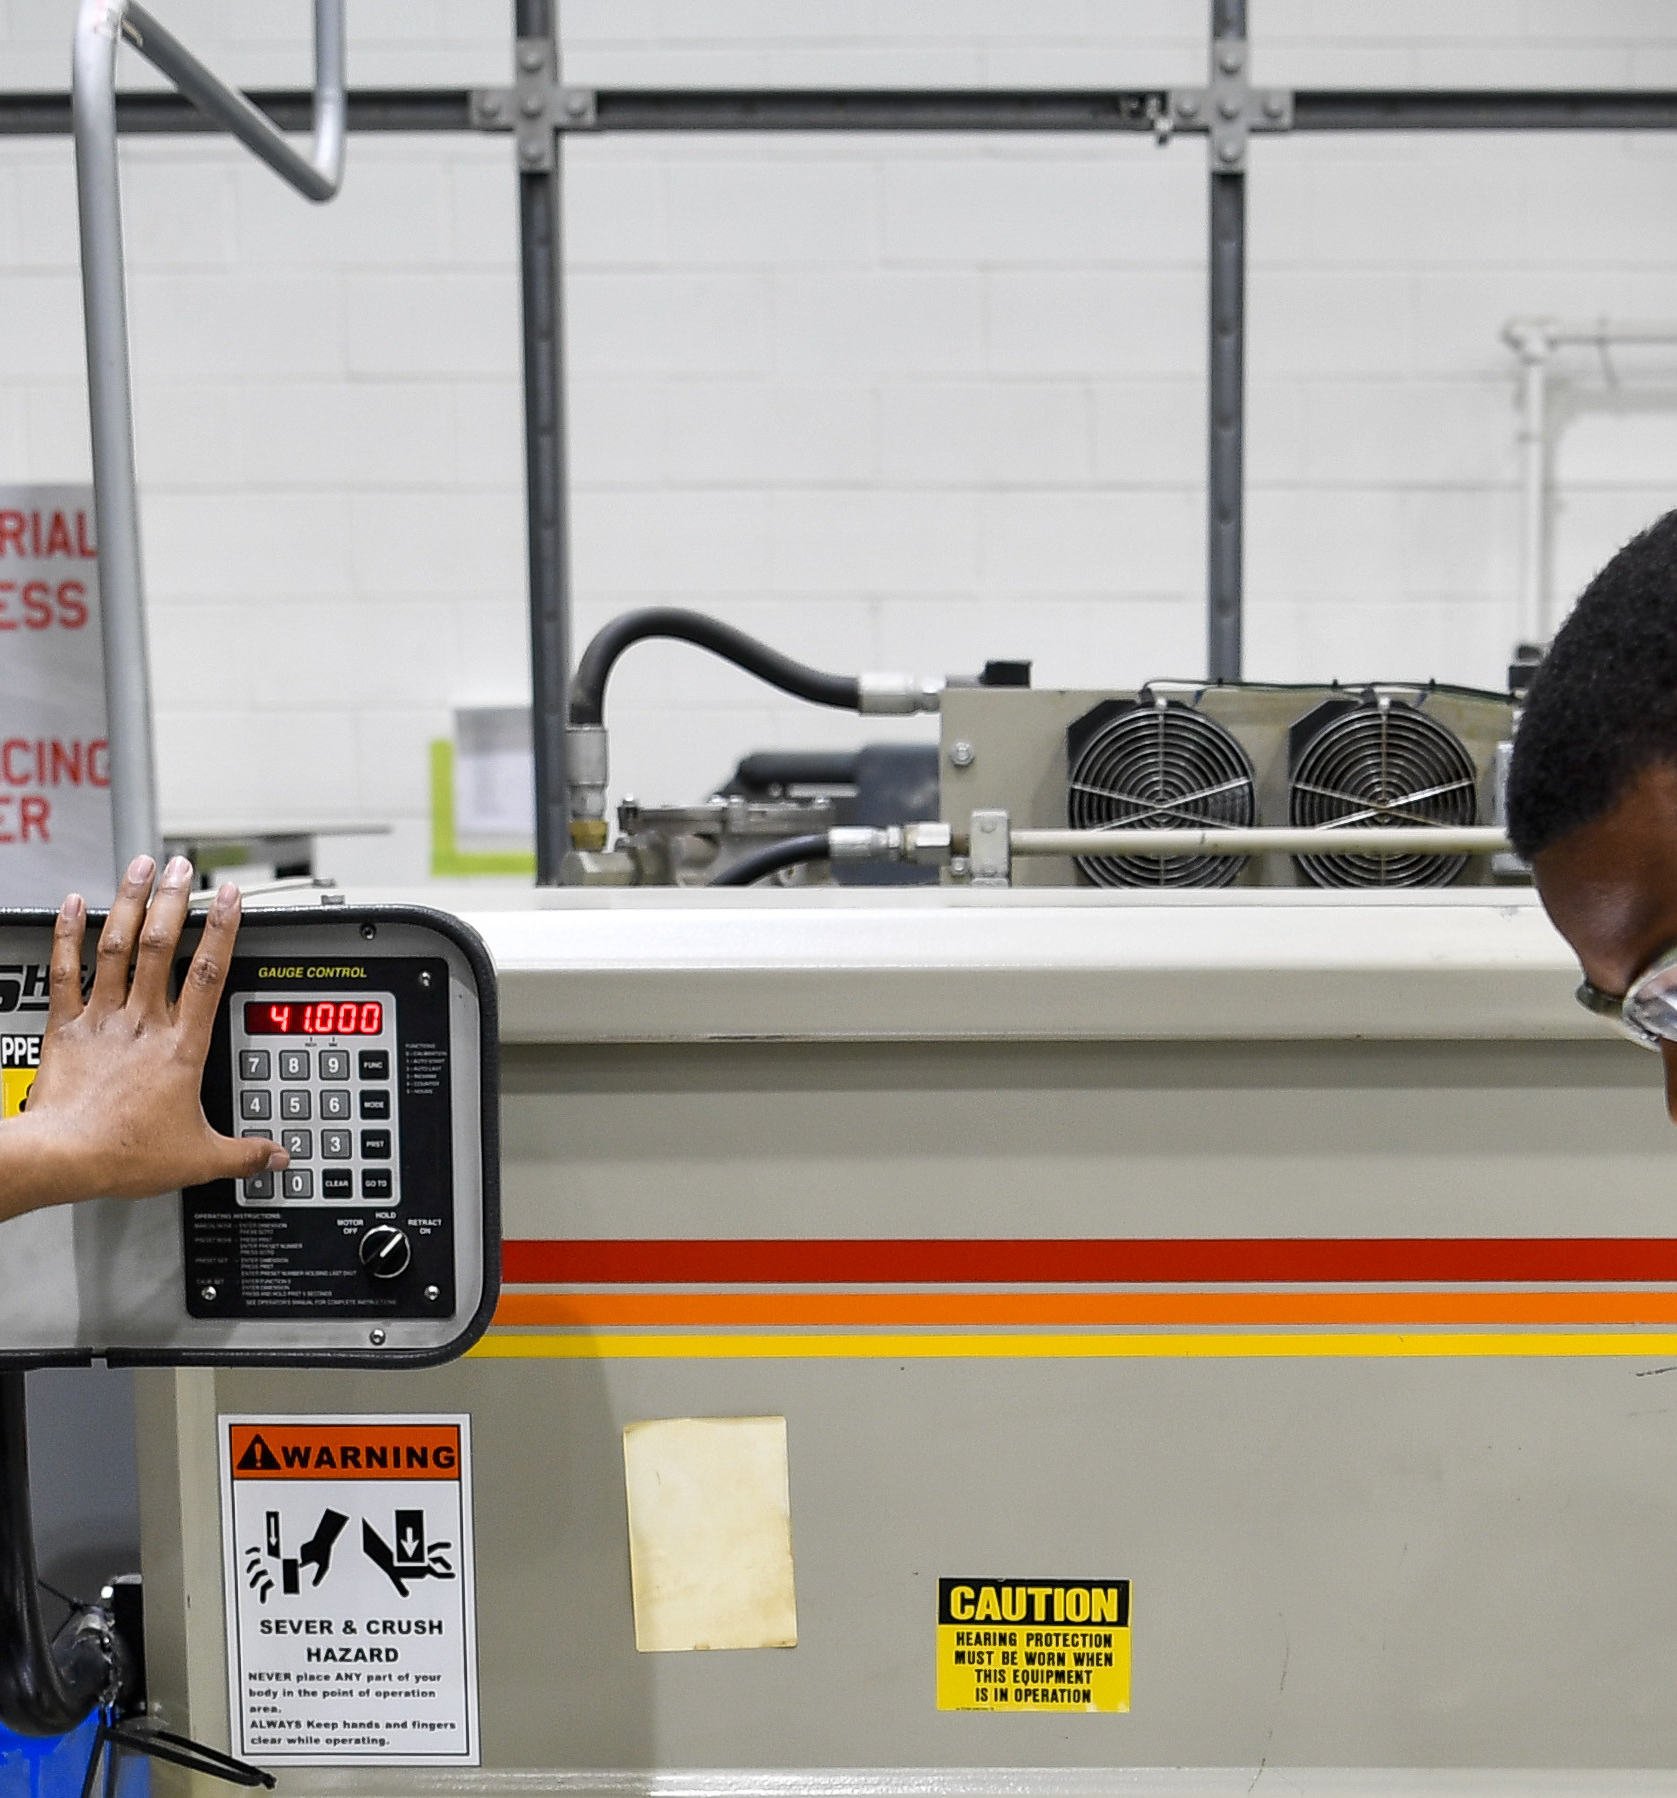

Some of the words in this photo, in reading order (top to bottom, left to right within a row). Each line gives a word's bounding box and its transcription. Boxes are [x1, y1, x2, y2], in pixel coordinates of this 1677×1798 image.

[258, 967, 303, 978] GAUGE
[306, 967, 367, 978] CONTROL
[1, 1036, 40, 1065] PPE
[249, 1058, 260, 1073] 7
[288, 1058, 299, 1073] 8
[328, 1058, 339, 1073] 9
[363, 1061, 383, 1069] FUNC
[249, 1098, 261, 1113] 4
[289, 1098, 300, 1113] 5
[329, 1098, 340, 1113] 6
[364, 1101, 384, 1109] MODE
[290, 1137, 302, 1152] 2
[330, 1137, 340, 1152] 3
[292, 1176, 302, 1192] 0
[281, 1446, 456, 1469] WARNING
[950, 1586, 1118, 1622] CAUTION
[260, 1619, 334, 1635] SEVER
[342, 1619, 357, 1635] &
[366, 1619, 444, 1635] CRUSH
[956, 1631, 1018, 1647] HEARING
[1026, 1632, 1113, 1648] PROTECTION
[307, 1647, 399, 1663] HAZARD
[955, 1650, 995, 1665] MUST
[1002, 1651, 1018, 1666] BE
[1025, 1652, 1066, 1666] WORN
[1073, 1652, 1113, 1667] WHEN
[248, 1672, 292, 1682] NEVER
[296, 1672, 331, 1684] place
[335, 1673, 362, 1682] ANY
[367, 1673, 393, 1684] part
[397, 1673, 410, 1682] of
[414, 1674, 442, 1684] your
[974, 1669, 1006, 1684] THIS
[1013, 1669, 1093, 1686] EQUIPMENT
[249, 1689, 278, 1700] body
[282, 1689, 294, 1698] in
[298, 1689, 318, 1698] the
[322, 1689, 354, 1700] point
[358, 1689, 371, 1698] of
[375, 1690, 436, 1700] operation
[976, 1687, 988, 1702] IS
[994, 1687, 1008, 1702] IN
[1014, 1688, 1091, 1703] OPERATION
[249, 1705, 282, 1714] area.
[250, 1720, 302, 1730] ALWAYS
[307, 1720, 339, 1732] Keep
[343, 1720, 381, 1730] hands
[385, 1720, 408, 1730] and
[412, 1720, 456, 1732] fingers
[250, 1736, 282, 1746] clear
[286, 1736, 320, 1746] while
[325, 1736, 390, 1748] operating.
